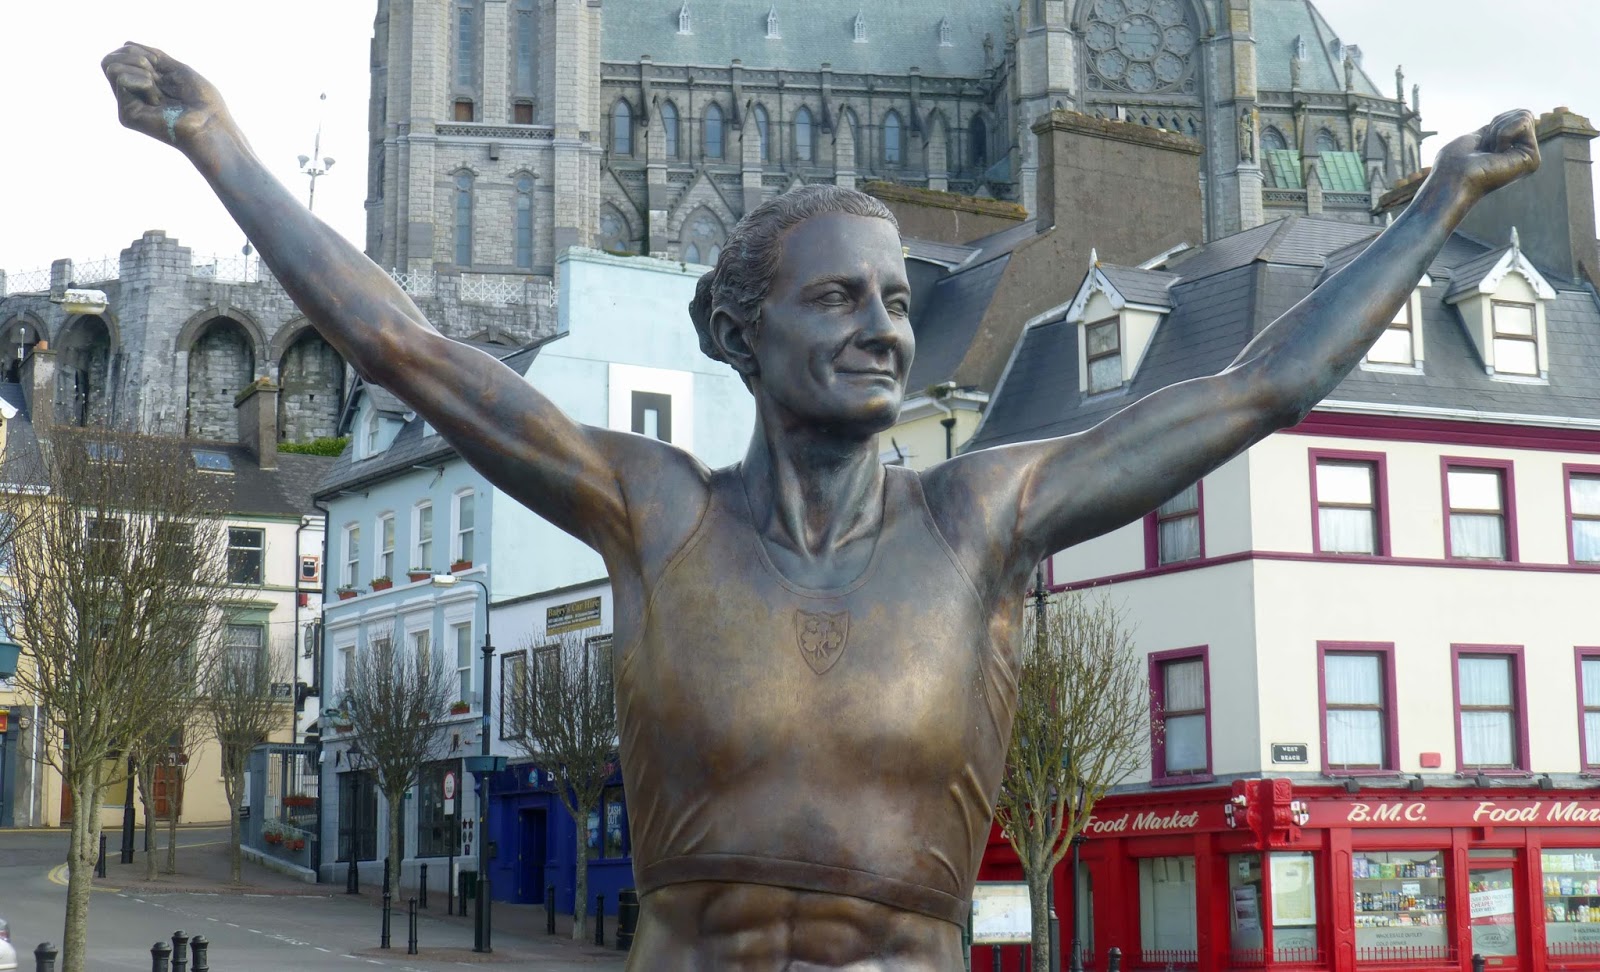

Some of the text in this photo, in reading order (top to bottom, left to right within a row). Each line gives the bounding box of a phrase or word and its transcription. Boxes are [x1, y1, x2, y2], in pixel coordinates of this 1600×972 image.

[1082, 813, 1130, 834] Food
[1132, 810, 1200, 831] Market
[1347, 802, 1427, 822] B.M.C.
[1472, 801, 1542, 822] Food
